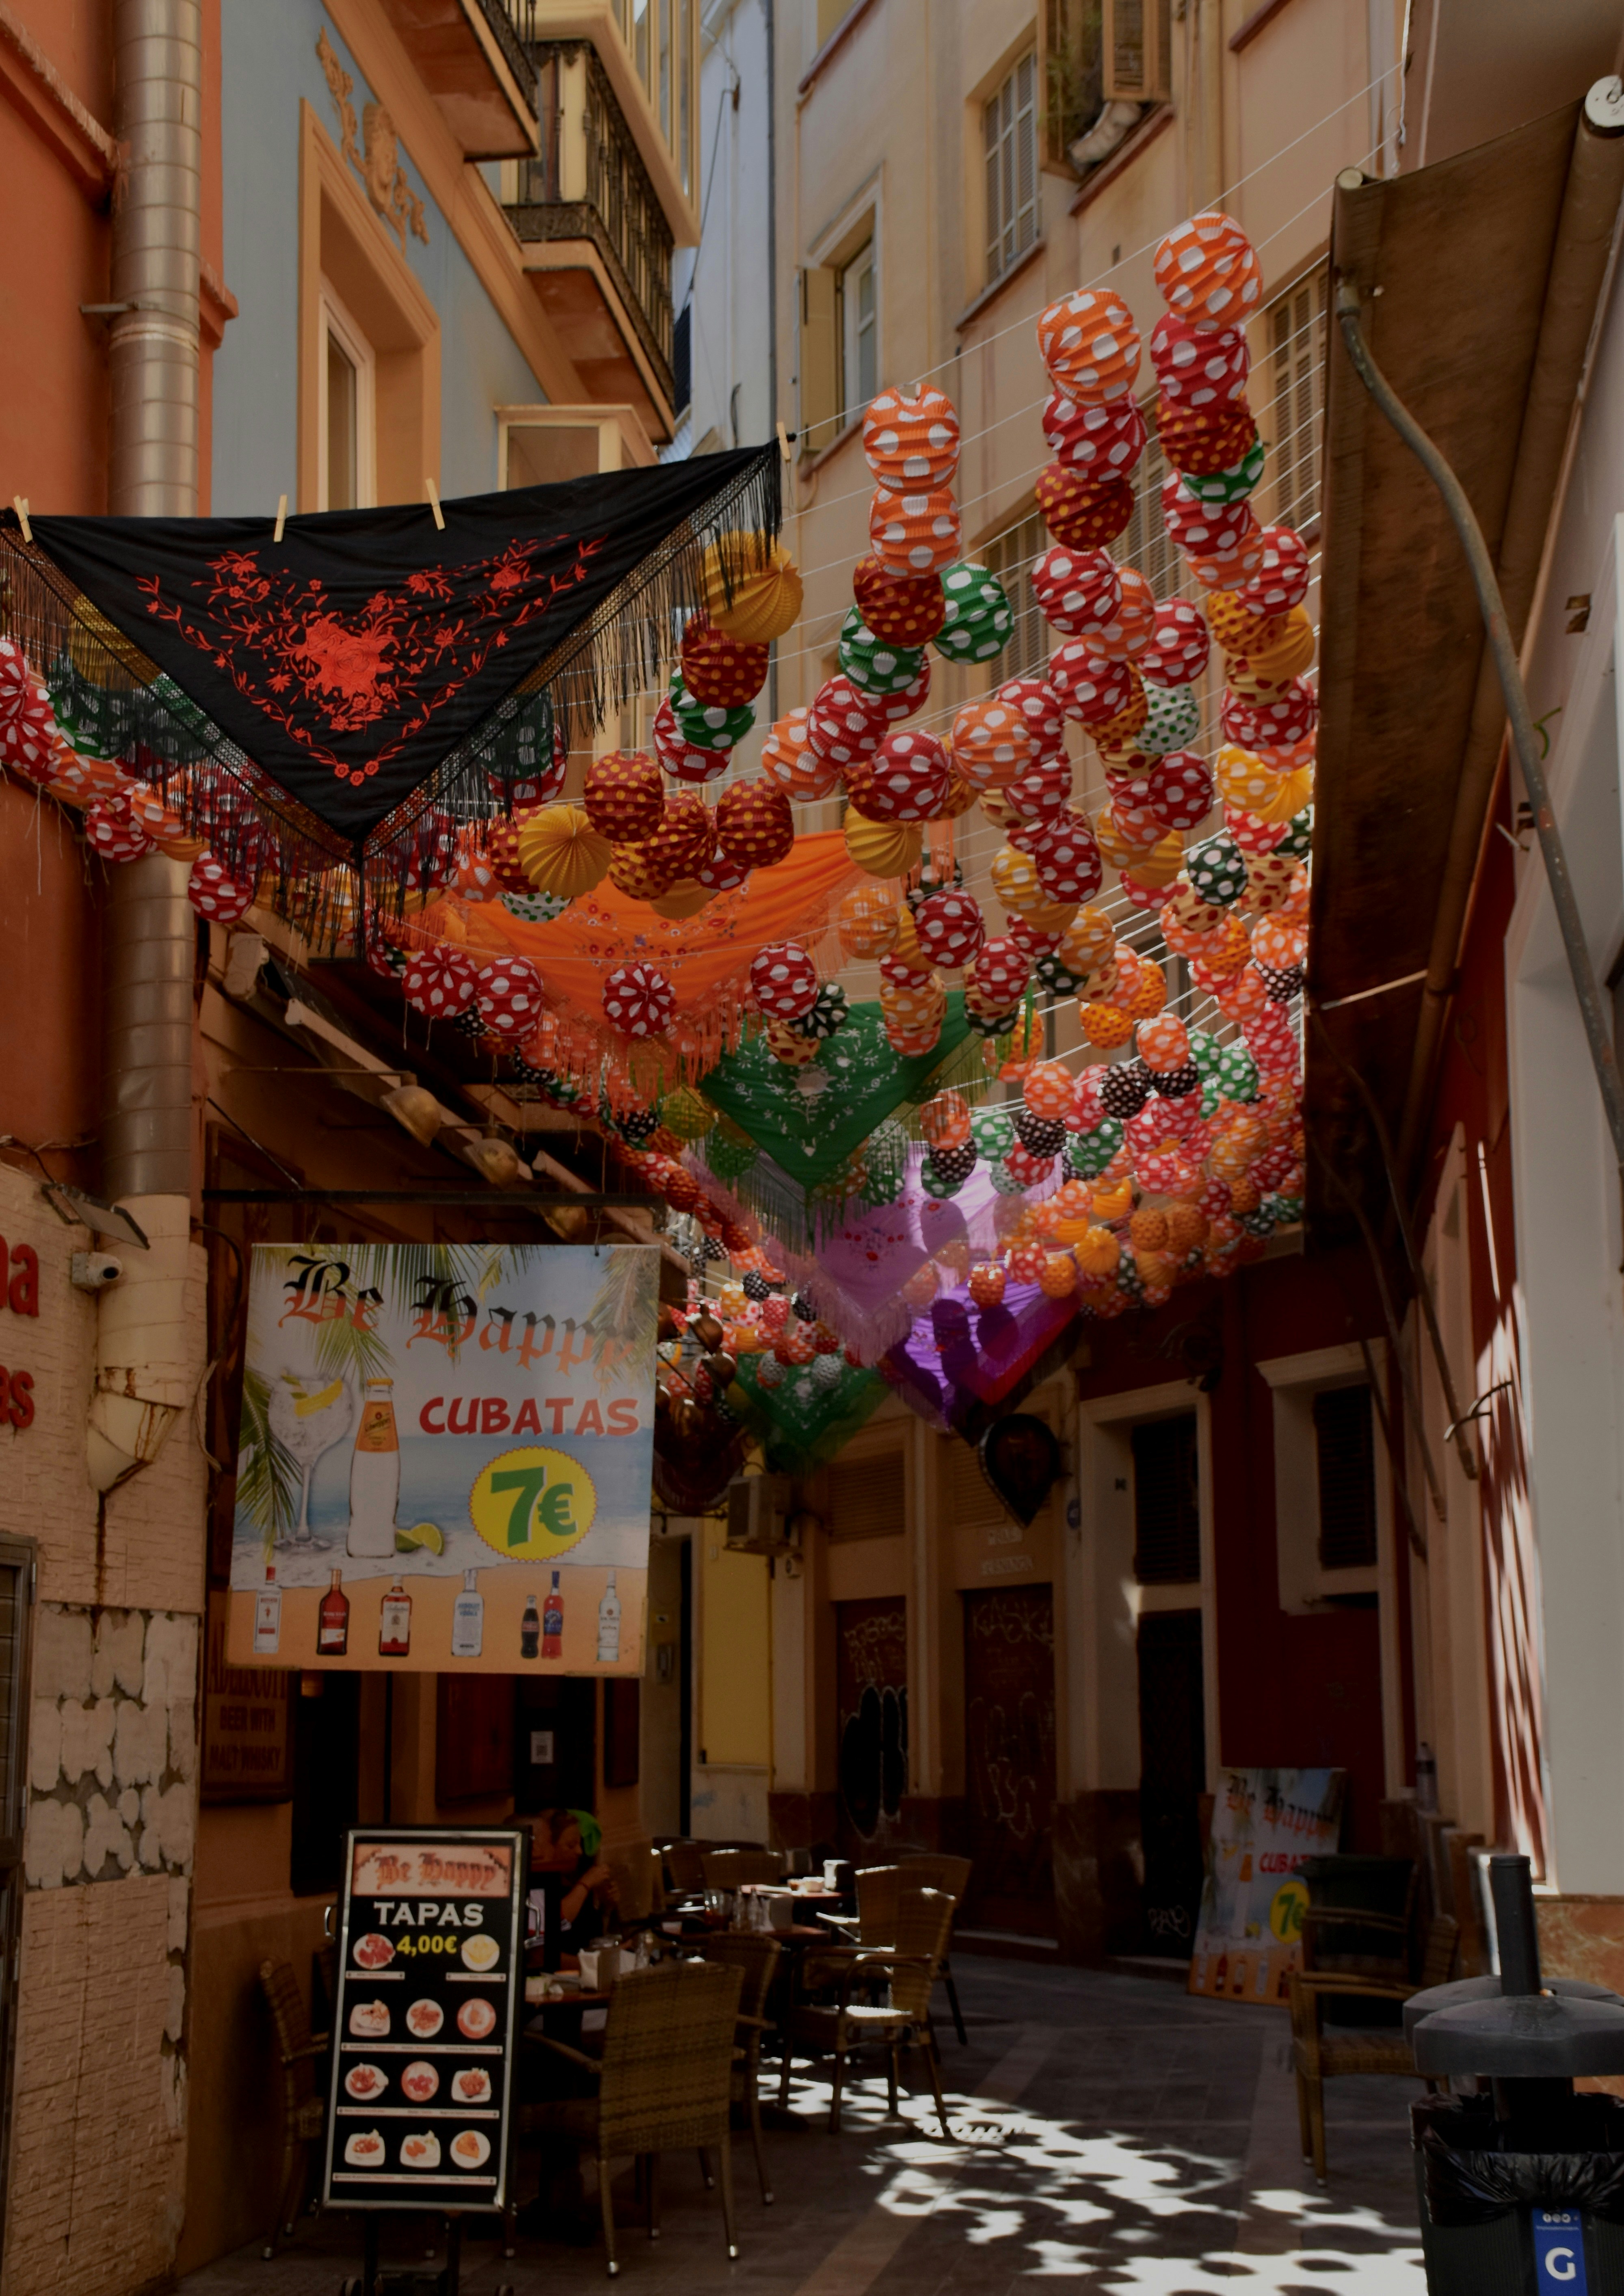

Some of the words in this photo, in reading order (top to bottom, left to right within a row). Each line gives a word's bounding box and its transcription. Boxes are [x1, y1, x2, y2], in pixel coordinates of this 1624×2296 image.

[278, 1255, 384, 1331] Be
[406, 1276, 636, 1389] Happy
[420, 1397, 639, 1436] CUBATAS
[490, 1465, 578, 1548] 7€
[221, 1706, 247, 1730] BEER
[250, 1707, 275, 1731] WITH
[210, 1744, 239, 1770] MALT
[241, 1746, 281, 1771] WHISKY
[374, 1855, 411, 1890] Be
[418, 1853, 496, 1891] Happy
[373, 1901, 484, 1927] TAPAS
[396, 1935, 457, 1957] 4,00€
[1545, 2247, 1576, 2281] G
